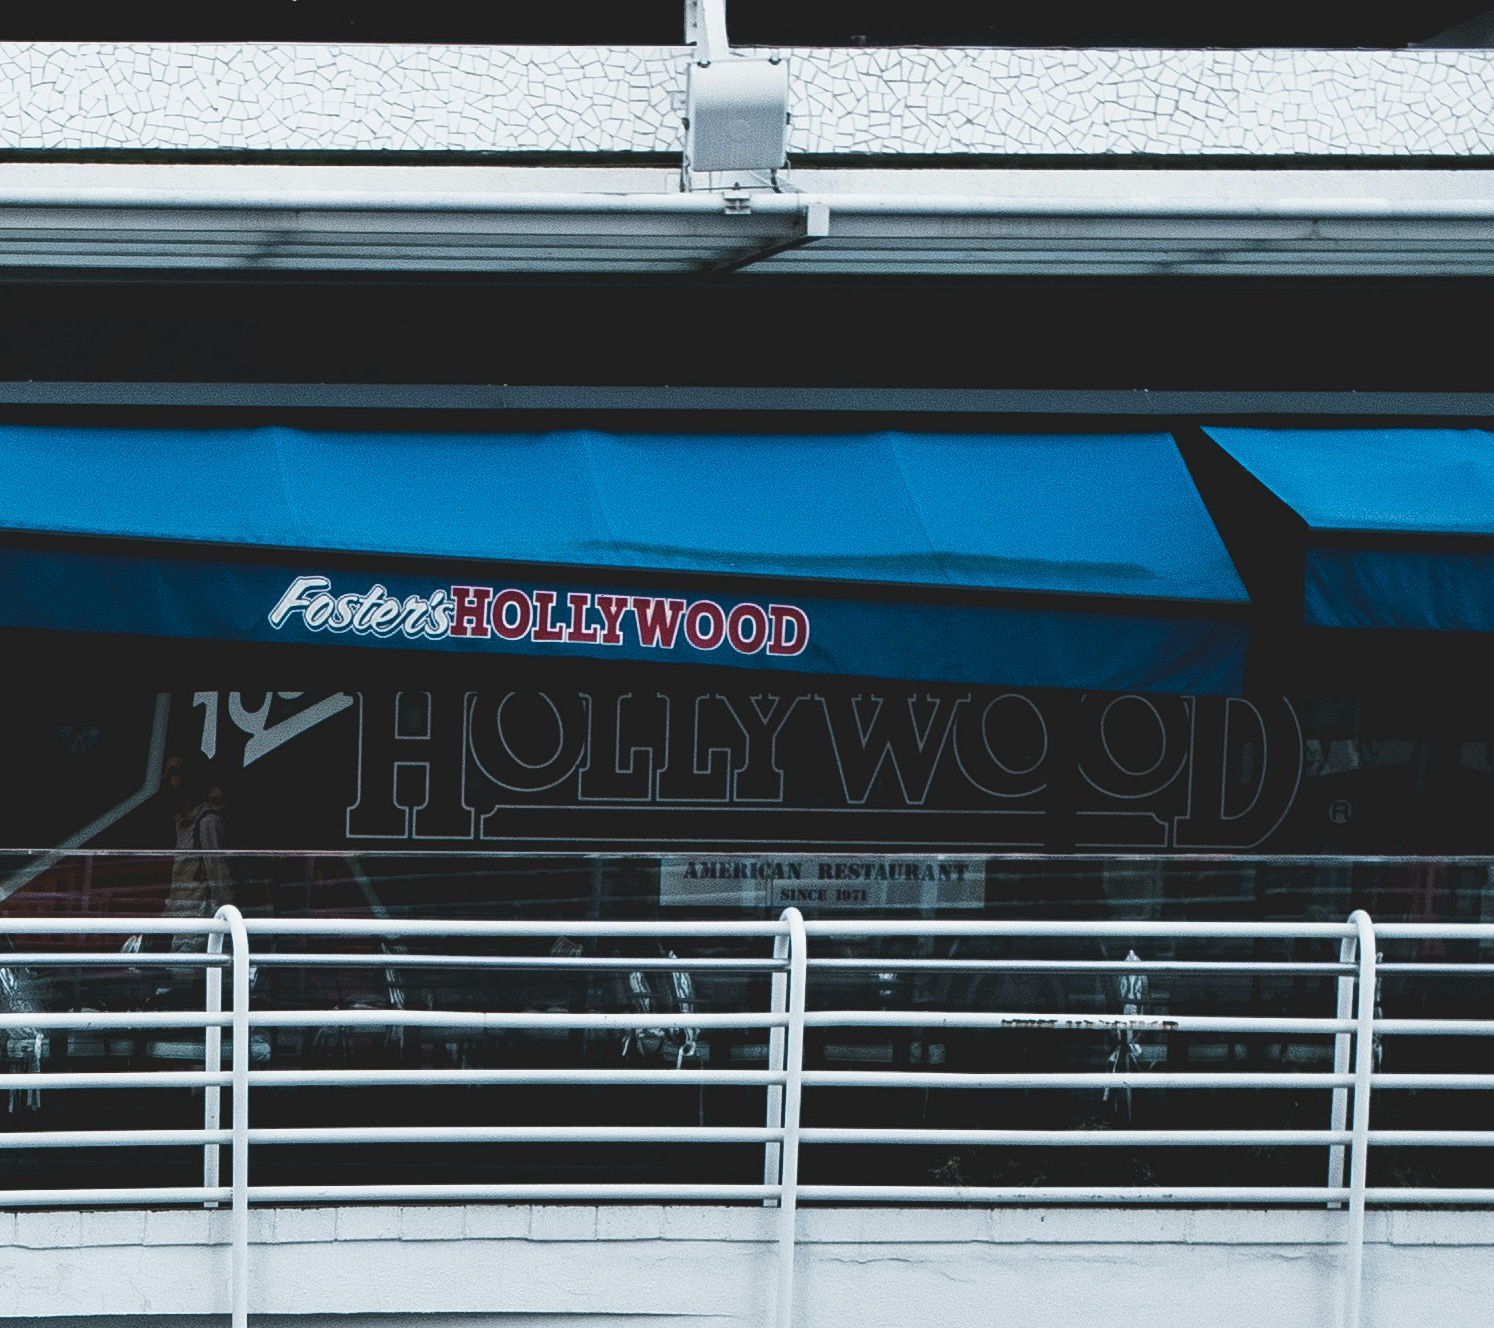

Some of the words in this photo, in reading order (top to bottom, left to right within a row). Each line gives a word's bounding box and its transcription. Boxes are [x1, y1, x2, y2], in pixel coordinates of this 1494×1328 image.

[268, 576, 454, 639] Foster's
[449, 585, 810, 656] HOLLYWOOD
[346, 690, 1303, 849] HOLLYWOOD
[683, 861, 802, 880] AMERICAN
[817, 863, 969, 882] RESTAURANT
[780, 889, 826, 901] SINCE
[835, 889, 867, 901] 1971
